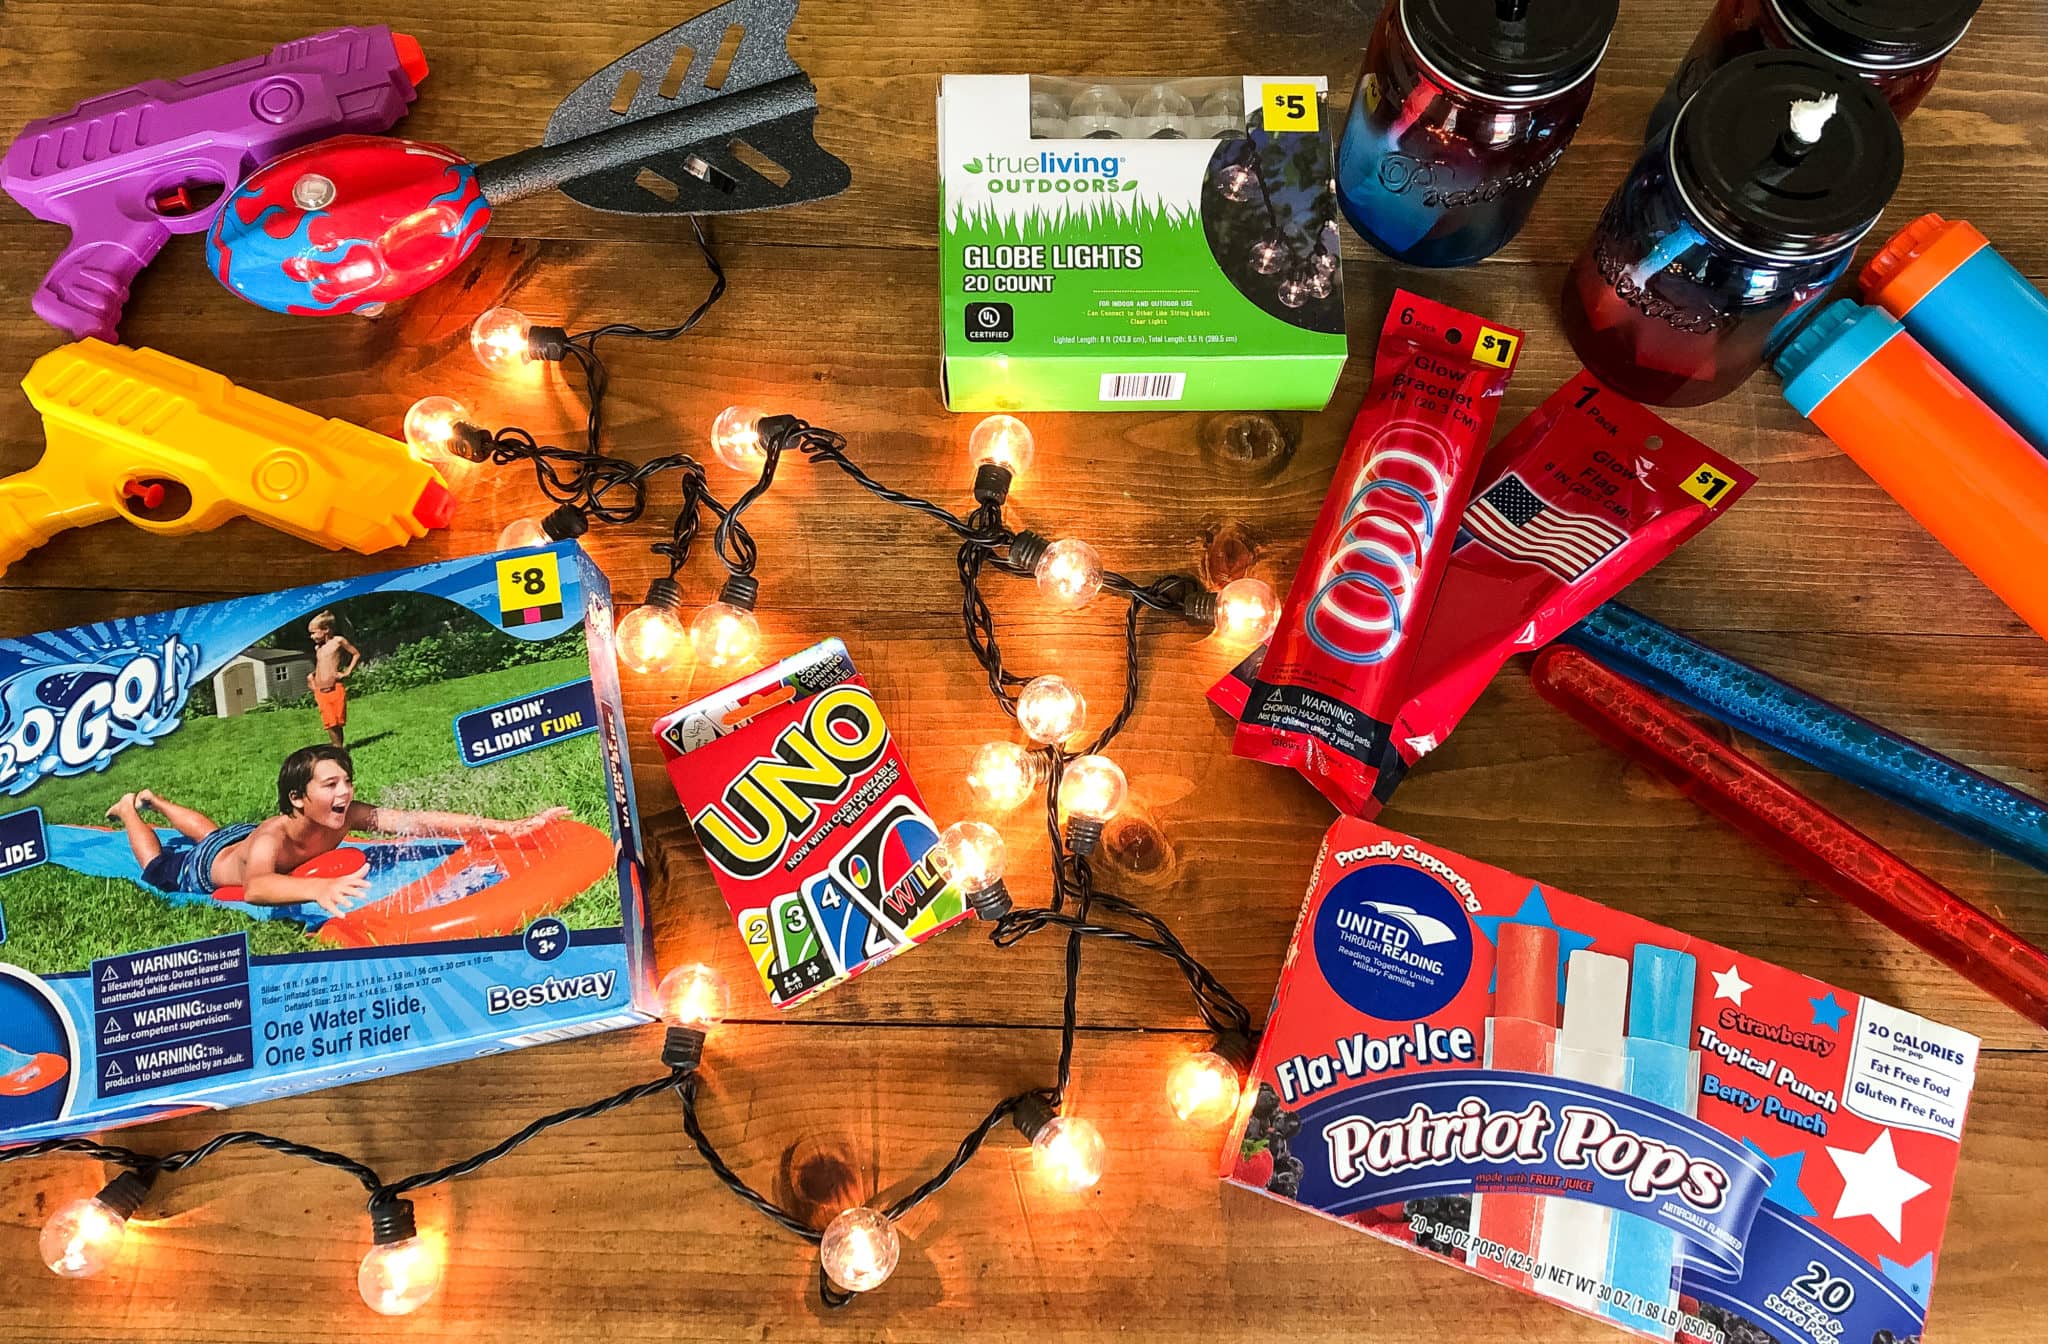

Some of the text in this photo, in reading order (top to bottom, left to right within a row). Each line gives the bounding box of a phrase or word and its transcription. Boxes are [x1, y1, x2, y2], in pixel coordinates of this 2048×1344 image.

[1275, 95, 1306, 119] $5
[987, 179, 1120, 193] OUTDOORS
[964, 244, 1142, 269] GLOBE LIGHTS
[964, 275, 1055, 292] 20 COUNT
[983, 311, 994, 323] UL
[1400, 307, 1436, 333] 6 Pack
[1053, 336, 1075, 344] Lighted
[1482, 335, 1512, 363] $1
[1414, 355, 1467, 382] Glow
[1392, 373, 1473, 409] Bracelet
[1452, 408, 1480, 432] CM)
[1573, 386, 1620, 438] 1 Pack
[1592, 450, 1638, 481] Glow
[1554, 470, 1632, 521] IN CM)
[1579, 467, 1620, 497] Flag
[1695, 471, 1728, 502] $1
[511, 567, 546, 596] $8
[806, 655, 843, 688] WINNING
[819, 666, 843, 689] RULE
[1262, 703, 1372, 749] CHOKING HAZARD Small parts.
[1301, 694, 1357, 727] WARNING:
[472, 711, 583, 758] SLIDIN' FUN!
[1258, 712, 1356, 751] Not for children under years.
[692, 684, 891, 880] UNO
[844, 769, 900, 824] WILD CARDS!
[787, 758, 897, 868] NOW WITH CUSTOMIZABLE
[1334, 841, 1482, 913] Proudly Supporting
[821, 883, 842, 909] 4
[530, 925, 560, 939] AGES
[750, 920, 768, 944] 2
[786, 905, 807, 932] 3
[1336, 908, 1409, 948] UNITED
[538, 940, 556, 954] 3+
[1340, 930, 1382, 952] THROUGH
[107, 959, 238, 993] lifesaving device. Do not leave child
[131, 948, 240, 975] WARNING: This not
[1338, 945, 1435, 985] Reading Together Unites
[1353, 960, 1416, 988] Military Families
[102, 974, 226, 1005] unattended while device in use.
[261, 987, 328, 1006] Rider: Inflated Size:
[285, 997, 331, 1012] Deflated Size:
[487, 969, 615, 1015] Bestway
[134, 998, 242, 1027] WARNING: Use only
[264, 995, 426, 1041] One Water Slide,
[104, 1013, 232, 1045] under competent supervision.
[266, 1024, 411, 1066] One Surf Rider
[1719, 1007, 1835, 1058] Strawberry
[1868, 1022, 1964, 1065] 20 CALORIES
[136, 1044, 223, 1071] WARNING: This
[1893, 1045, 1923, 1060] per pop
[105, 1053, 244, 1091] product to be assembled by an adult.
[1697, 1025, 1838, 1113] Tropical Punch
[1870, 1059, 1951, 1097] Fat Free Food
[1702, 1074, 1827, 1136] Berry Punch
[1855, 1081, 1955, 1129] Gluten Free Food
[1323, 1096, 1731, 1214] Patriot Pops
[1476, 1172, 1503, 1183] made
[1506, 1173, 1526, 1184] with
[1530, 1173, 1562, 1186] FRUIT
[1563, 1177, 1595, 1192] JUICE
[1662, 1202, 1742, 1250] ARTIFICIALLY FLAVORED
[1411, 1215, 1715, 1341] 20 1.5 OZ POPS (42.5 g) NET WT 30 OZ (1.88 LB) 850.5
[1792, 1260, 1855, 1313] 20
[1764, 1294, 1805, 1327] Serve
[1781, 1286, 1844, 1336] Freeze &
